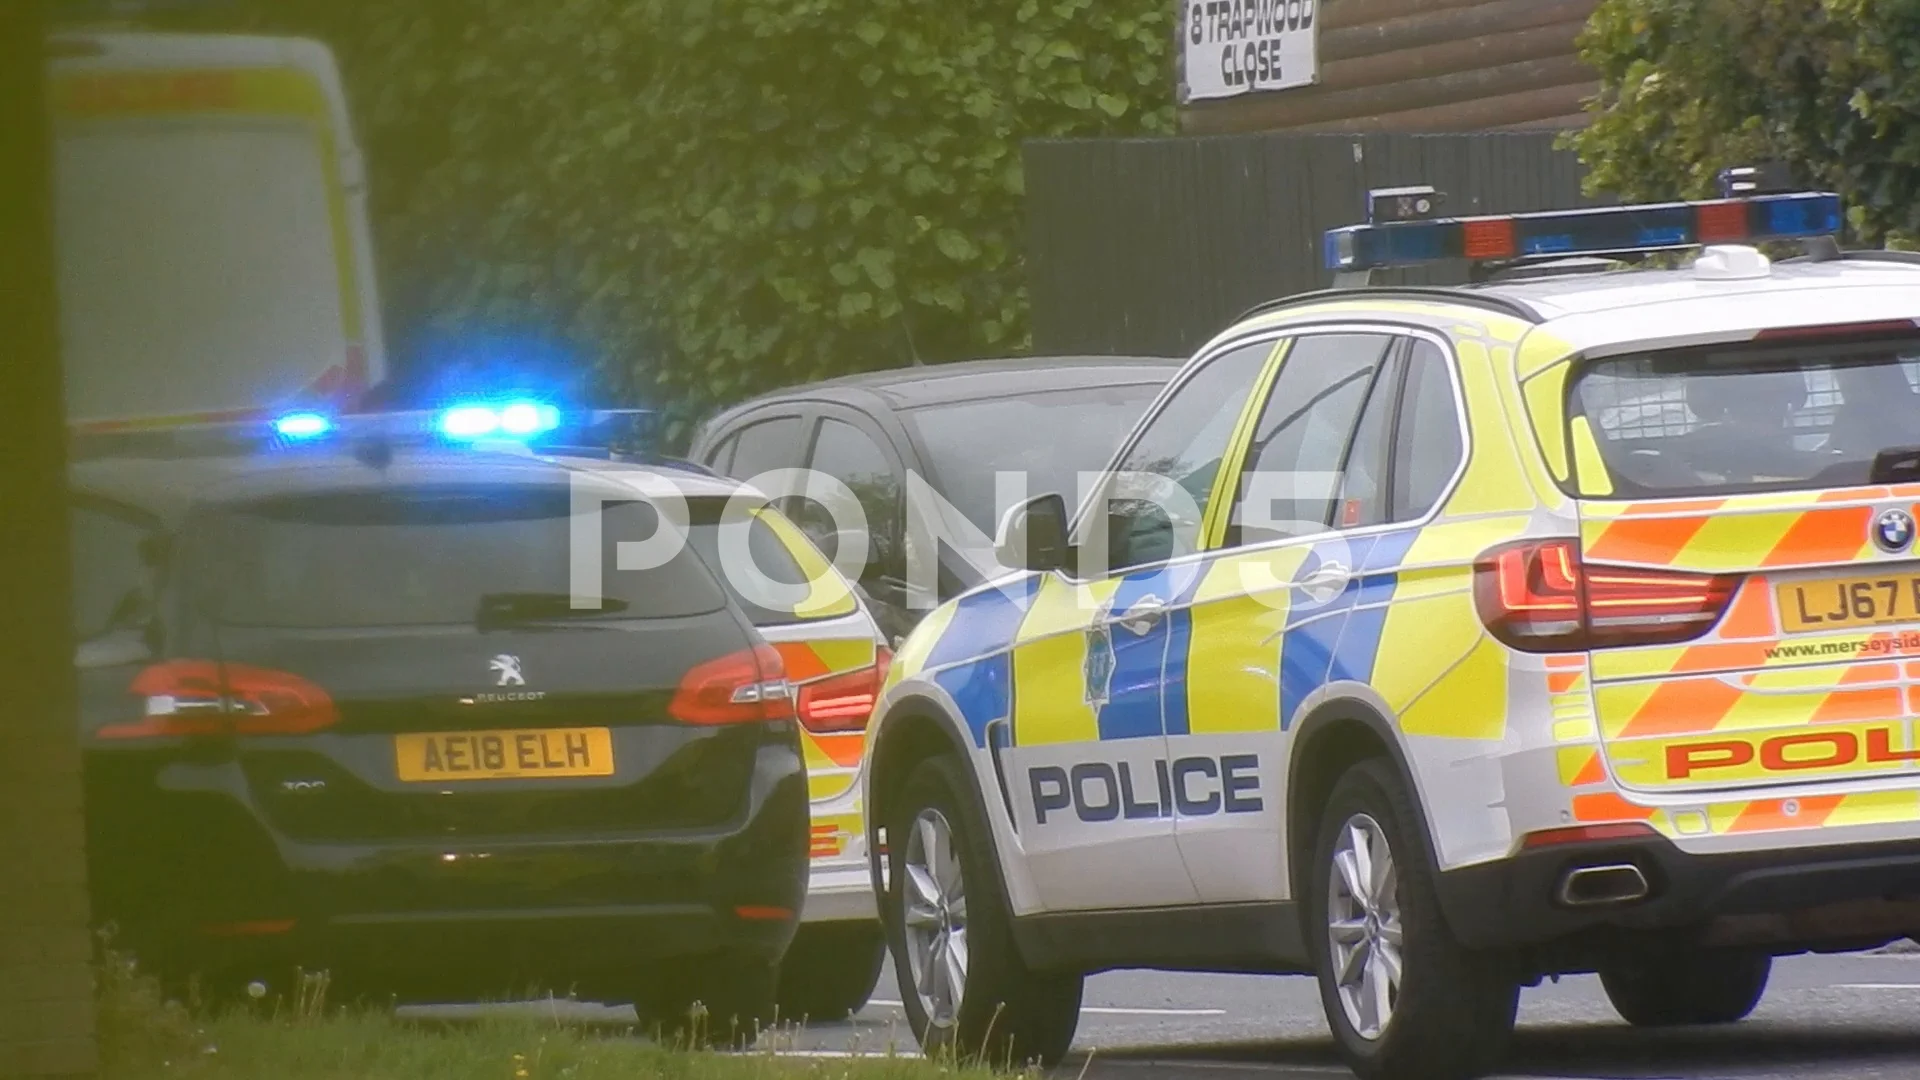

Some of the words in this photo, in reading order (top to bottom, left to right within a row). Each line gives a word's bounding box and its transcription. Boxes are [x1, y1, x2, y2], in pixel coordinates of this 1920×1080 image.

[1191, 3, 1203, 45] 8
[1206, 0, 1313, 43] TRAPWOOD
[1221, 39, 1282, 87] CLOSE
[1796, 580, 1899, 624] LJ67
[423, 736, 505, 773] AE18
[515, 733, 591, 770] ELH
[1028, 754, 1264, 825] POLICE
